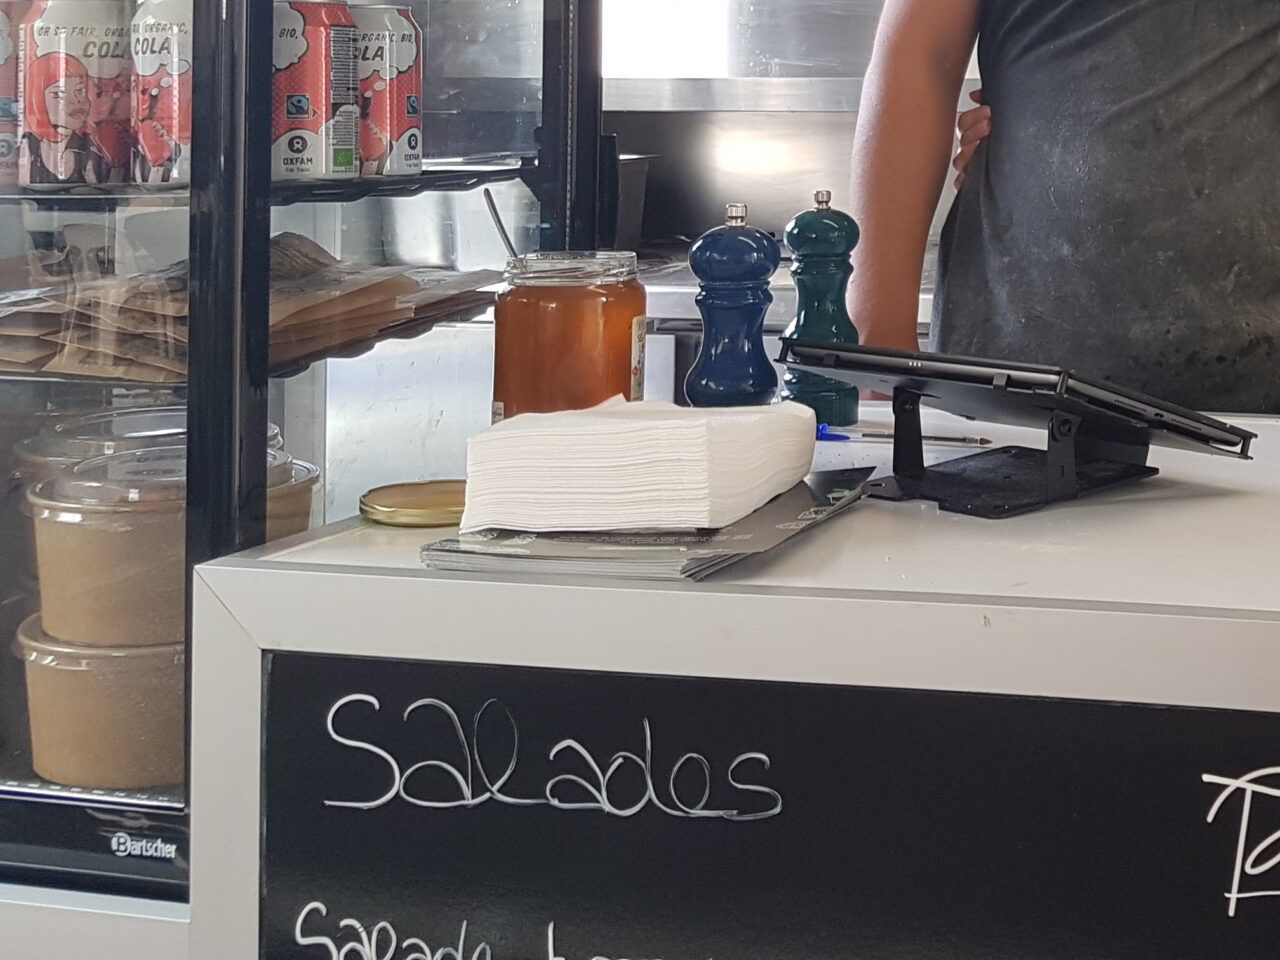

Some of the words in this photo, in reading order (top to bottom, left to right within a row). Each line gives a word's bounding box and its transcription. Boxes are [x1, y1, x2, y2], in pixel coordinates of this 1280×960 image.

[144, 23, 189, 34] ORGANC,
[134, 37, 172, 55] COLA
[283, 157, 313, 165] OXFAM
[324, 693, 782, 820] Salades
[111, 832, 177, 859] Bartscher
